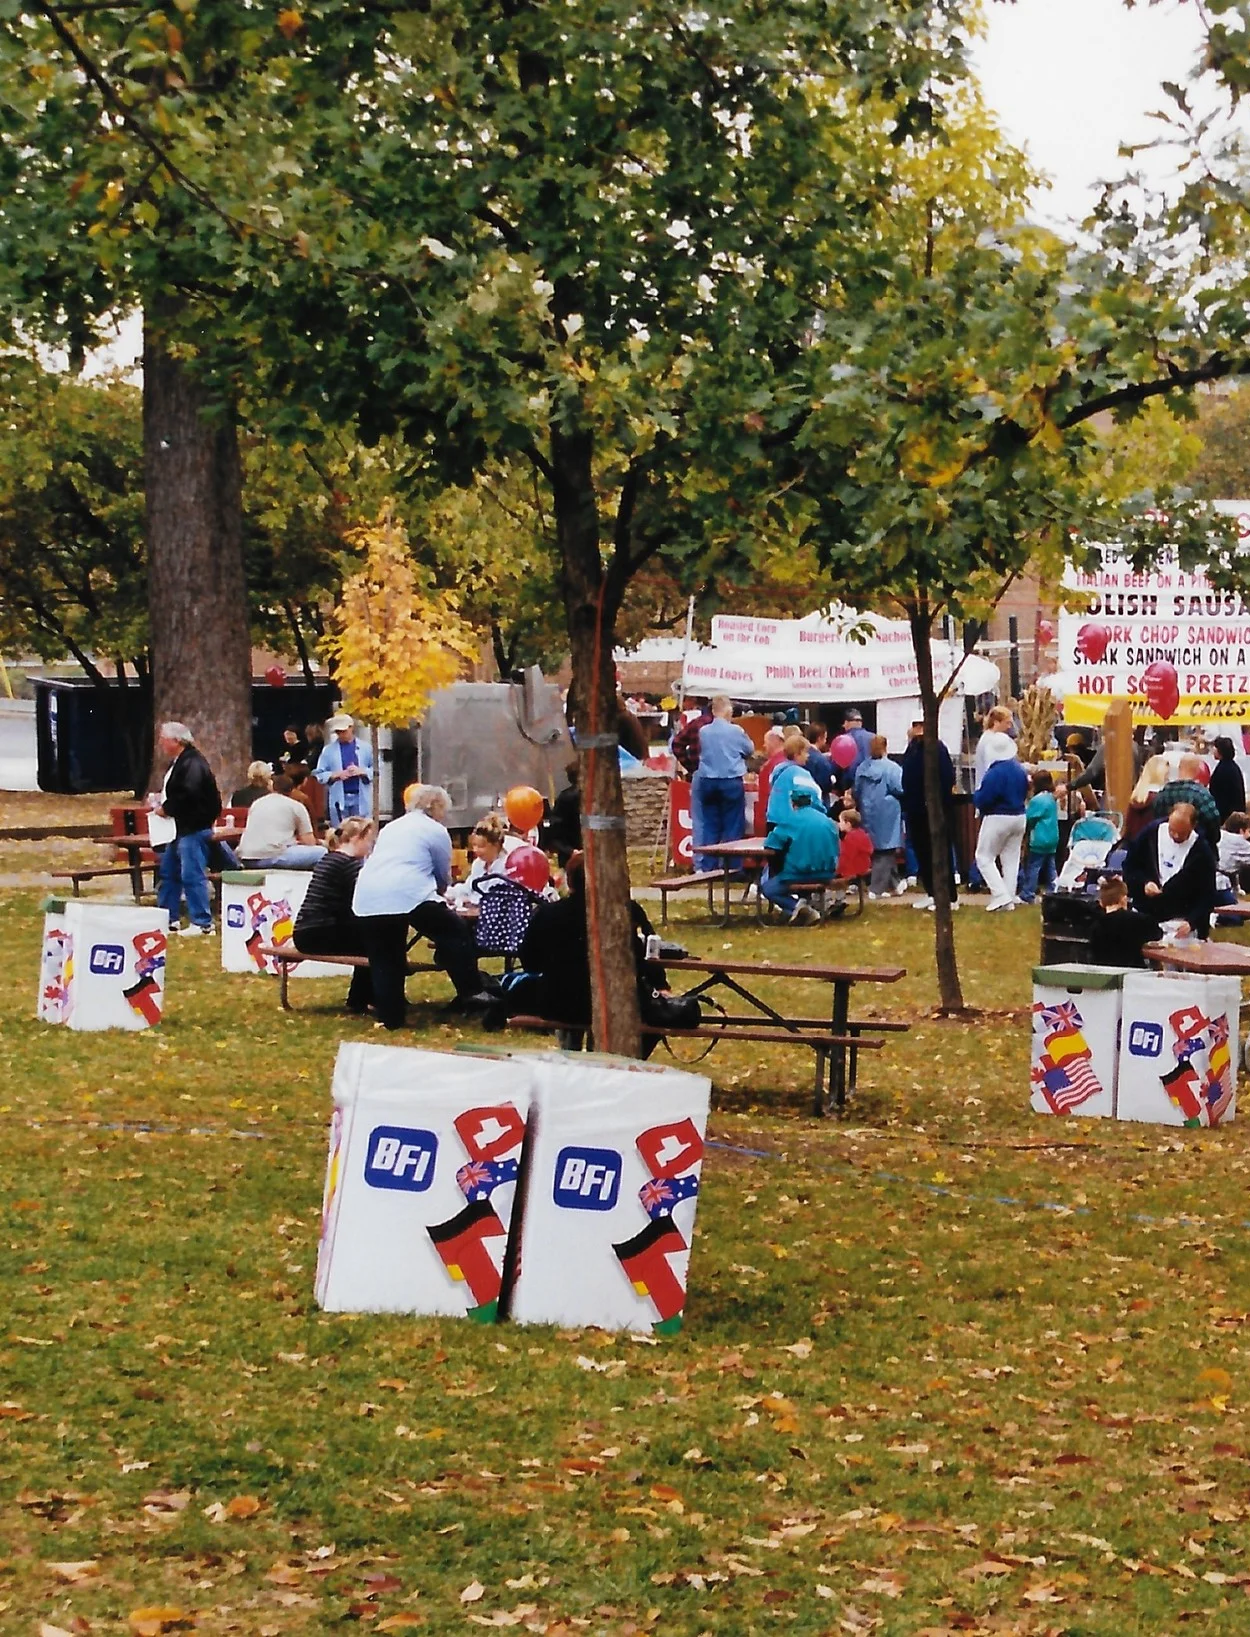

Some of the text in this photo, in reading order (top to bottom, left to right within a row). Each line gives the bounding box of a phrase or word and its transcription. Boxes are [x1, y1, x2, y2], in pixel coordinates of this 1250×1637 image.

[1077, 573, 1119, 587] ITALIAN
[1124, 573, 1151, 588] BEEF
[1156, 574, 1172, 588] ON
[1178, 574, 1185, 587] A
[1086, 594, 1157, 616] OLISH
[799, 630, 840, 644] Burgers
[1103, 625, 1132, 644] ORK
[1140, 624, 1179, 644] CHOP
[1126, 647, 1202, 666] SANDWICH
[1209, 647, 1229, 667] ON
[1237, 648, 1246, 666] A
[1078, 675, 1115, 694] HOT
[1127, 675, 1149, 694] SO
[1190, 699, 1250, 717] CAKES
[1132, 1028, 1160, 1052] BFI
[371, 1137, 431, 1183] BFI
[559, 1158, 616, 1202] BFI
